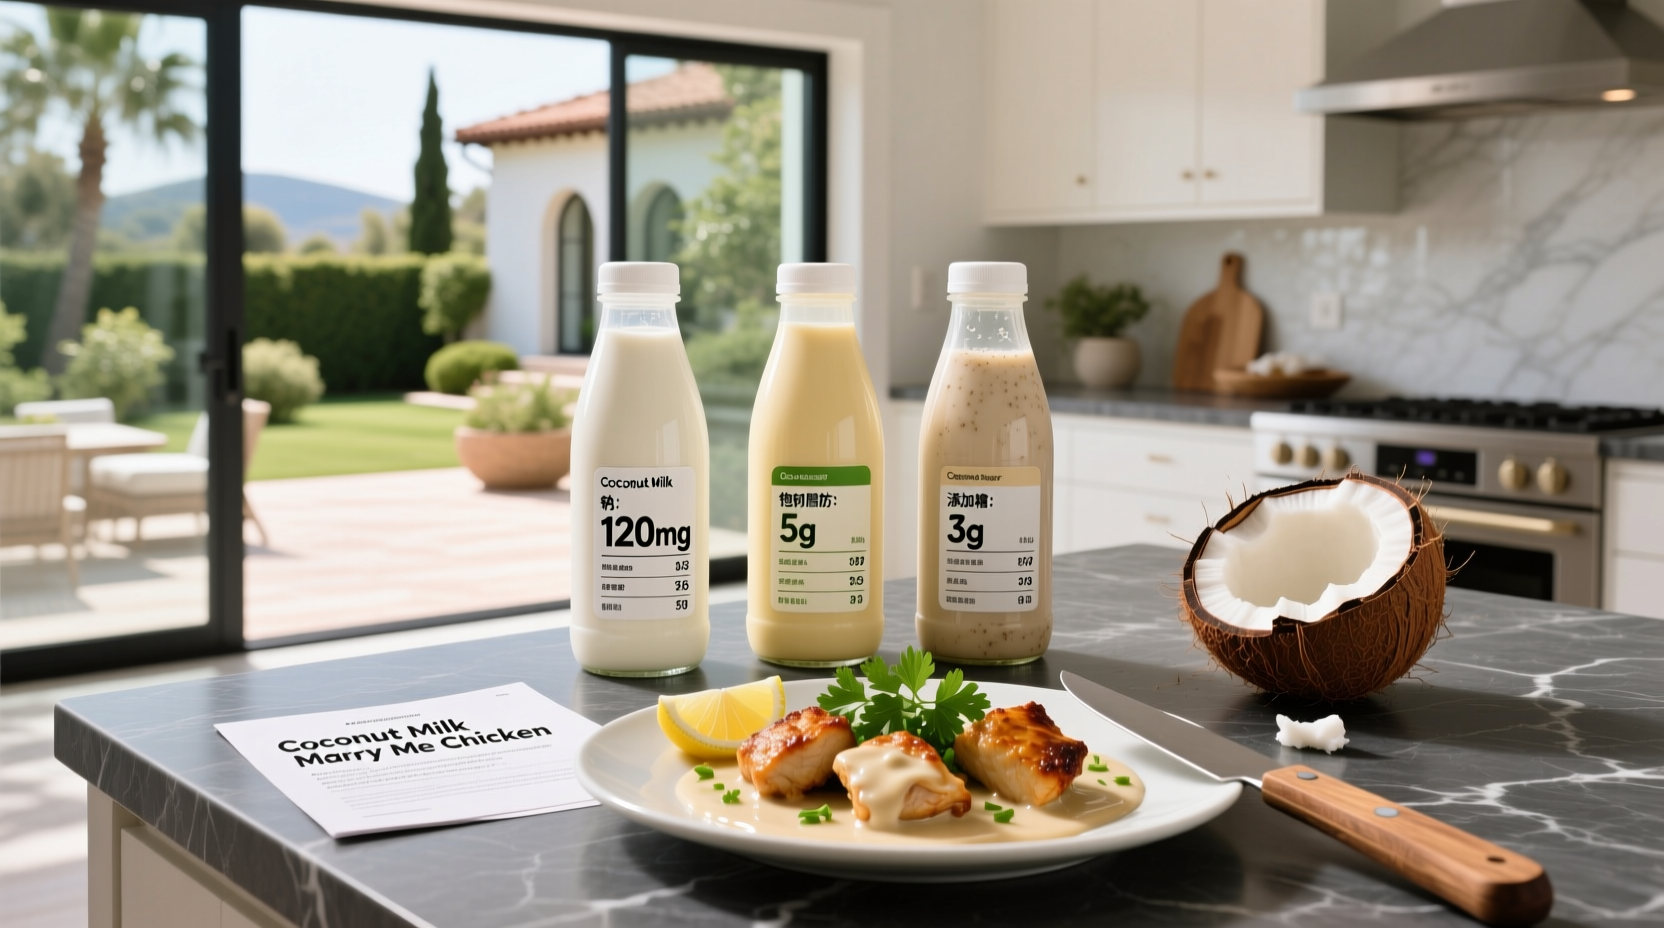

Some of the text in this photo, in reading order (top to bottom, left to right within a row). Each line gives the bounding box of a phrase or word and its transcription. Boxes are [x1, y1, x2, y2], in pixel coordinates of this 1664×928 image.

[600, 475, 674, 489] Coconut Milk
[600, 515, 691, 552] 120mg
[779, 512, 816, 549] 5g
[946, 513, 984, 550] 3g
[278, 728, 403, 752] Coconut
[406, 719, 471, 738] Milk
[293, 726, 553, 767] Marry Me Chicken
